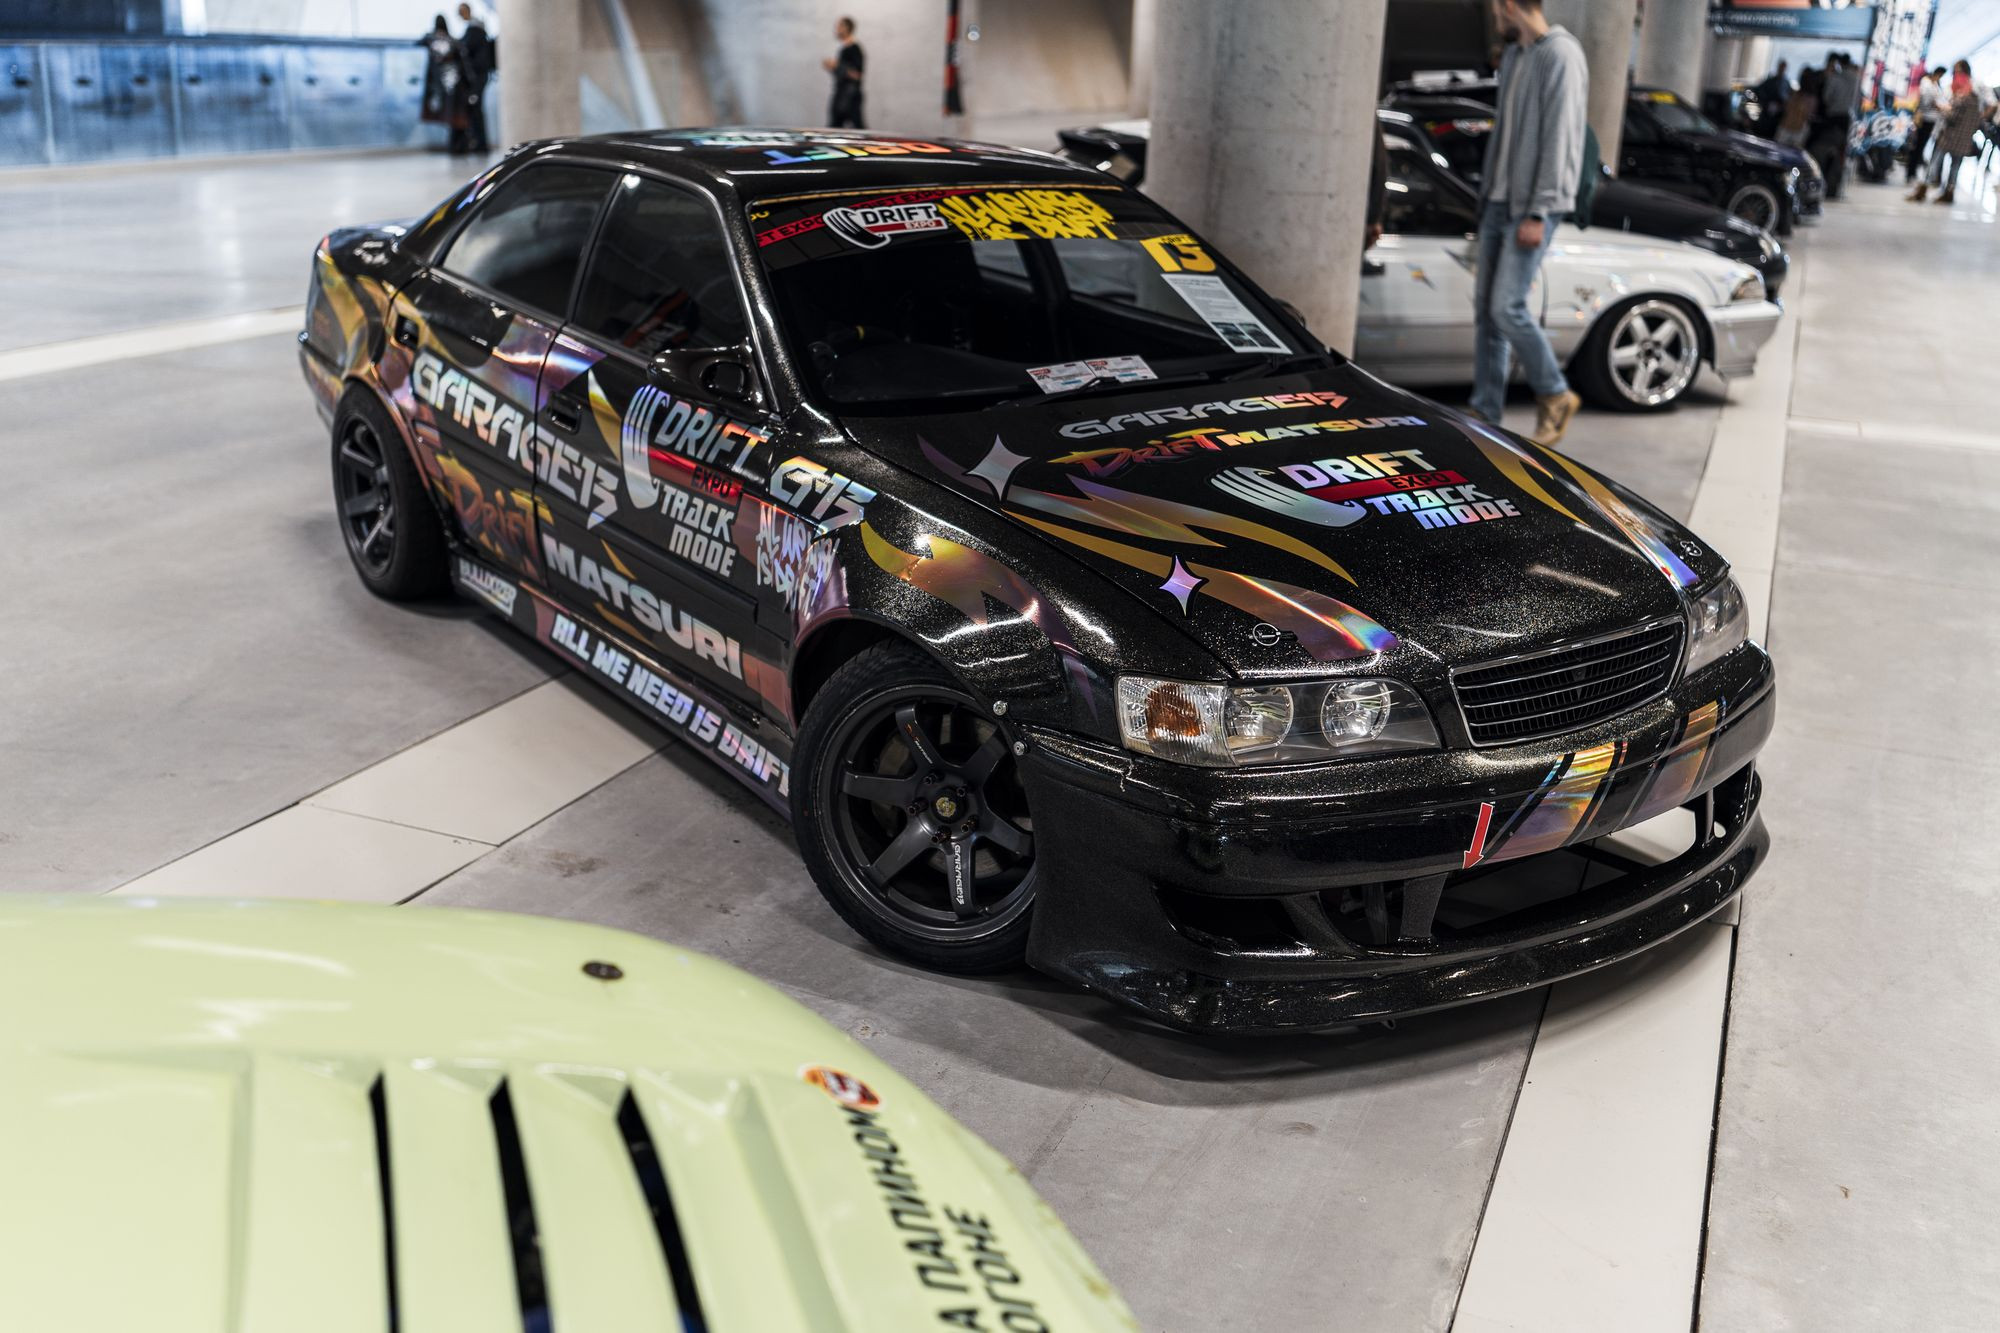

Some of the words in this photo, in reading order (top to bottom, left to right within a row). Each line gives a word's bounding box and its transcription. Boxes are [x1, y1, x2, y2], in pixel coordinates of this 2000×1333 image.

[861, 205, 935, 225] DRIFT
[904, 220, 937, 230] EXPO
[1058, 392, 1348, 439] GARAGE13
[1216, 416, 1428, 446] MATSURI
[413, 352, 619, 530] GARAGE13
[654, 401, 774, 473] DRIFT
[692, 466, 733, 499] EXPO
[1278, 449, 1437, 488] DRIFT
[1386, 473, 1451, 490] EXPO
[660, 485, 735, 543] TRACK
[1364, 483, 1493, 515] TRACK
[1413, 499, 1522, 530] MODE
[669, 524, 737, 577] MODE
[542, 533, 743, 680] MATSURI
[552, 613, 590, 661] ALL
[592, 640, 631, 684] WE
[627, 664, 695, 725] NEED
[689, 705, 722, 743] IS
[718, 722, 789, 798] DRIFT
